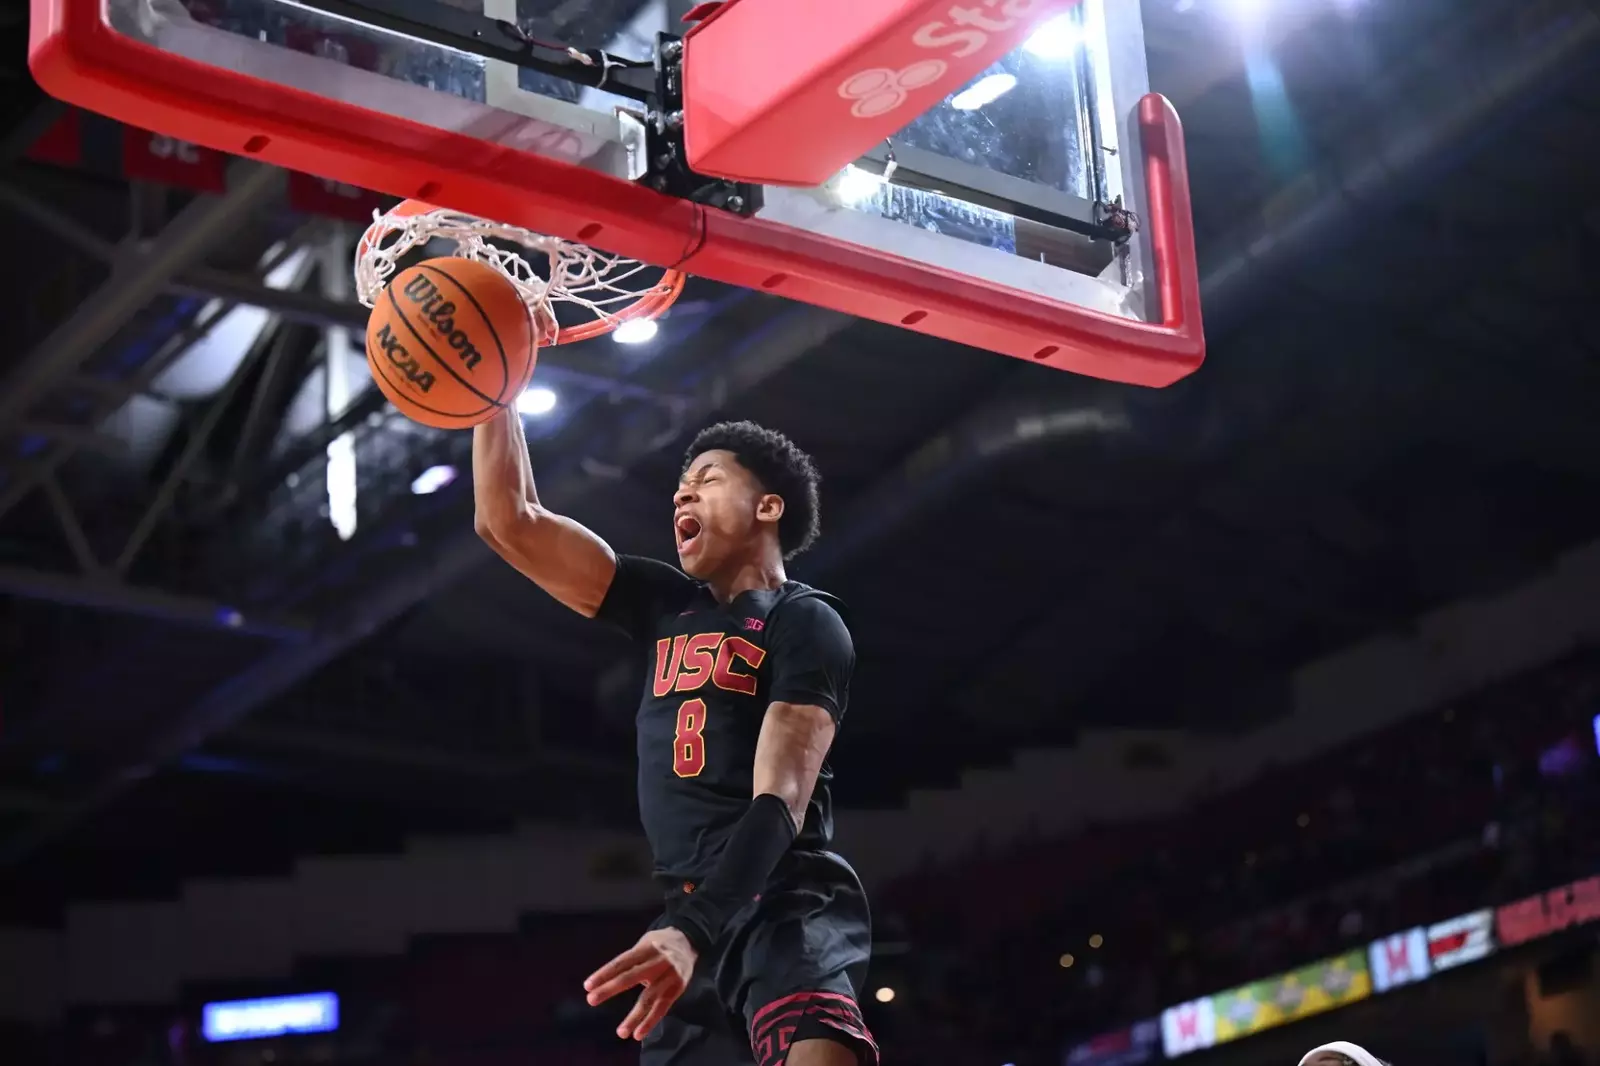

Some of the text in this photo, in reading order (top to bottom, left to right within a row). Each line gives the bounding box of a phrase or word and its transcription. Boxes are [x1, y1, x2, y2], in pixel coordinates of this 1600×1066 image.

[377, 323, 436, 393] NCAA
[404, 273, 482, 371] Wilson
[653, 632, 766, 696] USC
[673, 698, 706, 777] 8
